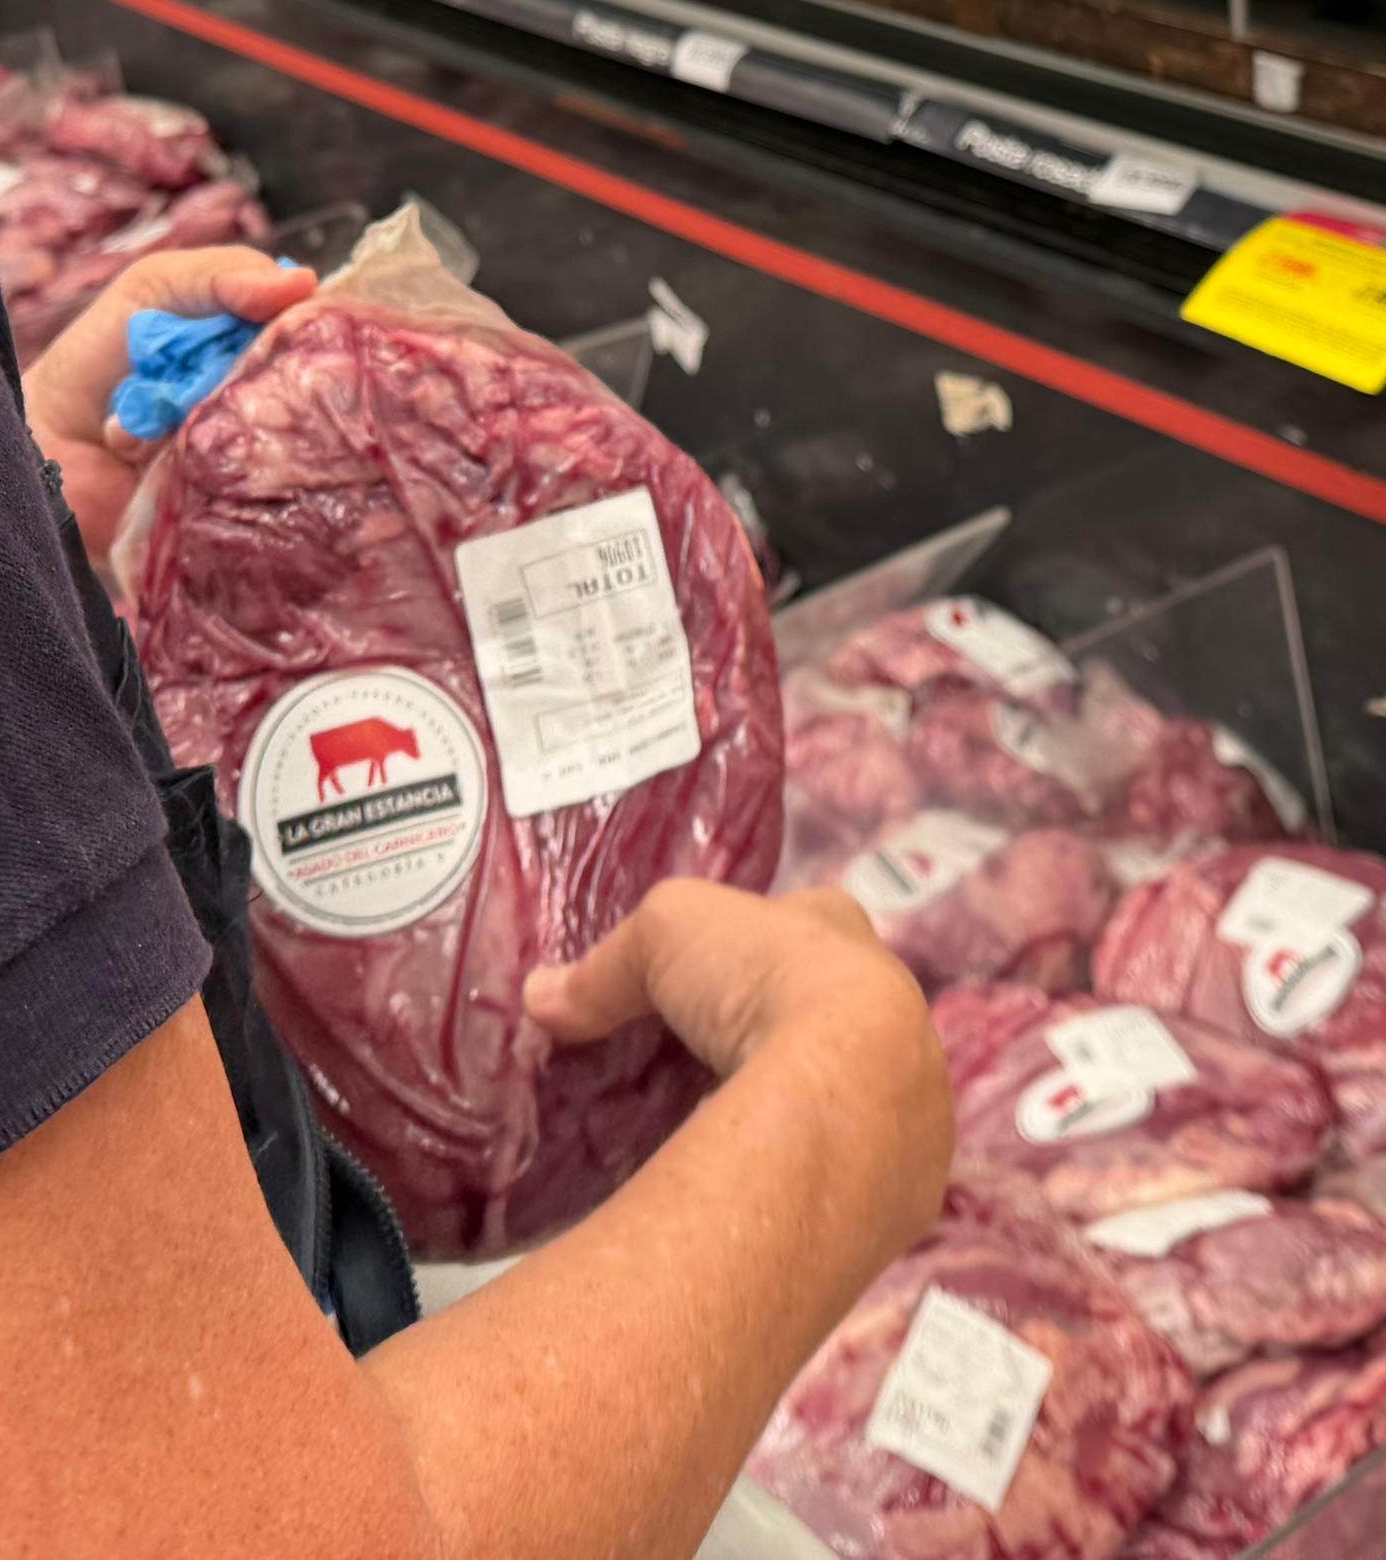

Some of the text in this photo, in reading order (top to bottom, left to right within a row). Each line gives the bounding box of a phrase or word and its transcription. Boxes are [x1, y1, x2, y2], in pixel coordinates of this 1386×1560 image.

[567, 566, 647, 598] TOTAL
[285, 784, 455, 846] LA GRAN ESTANCIA
